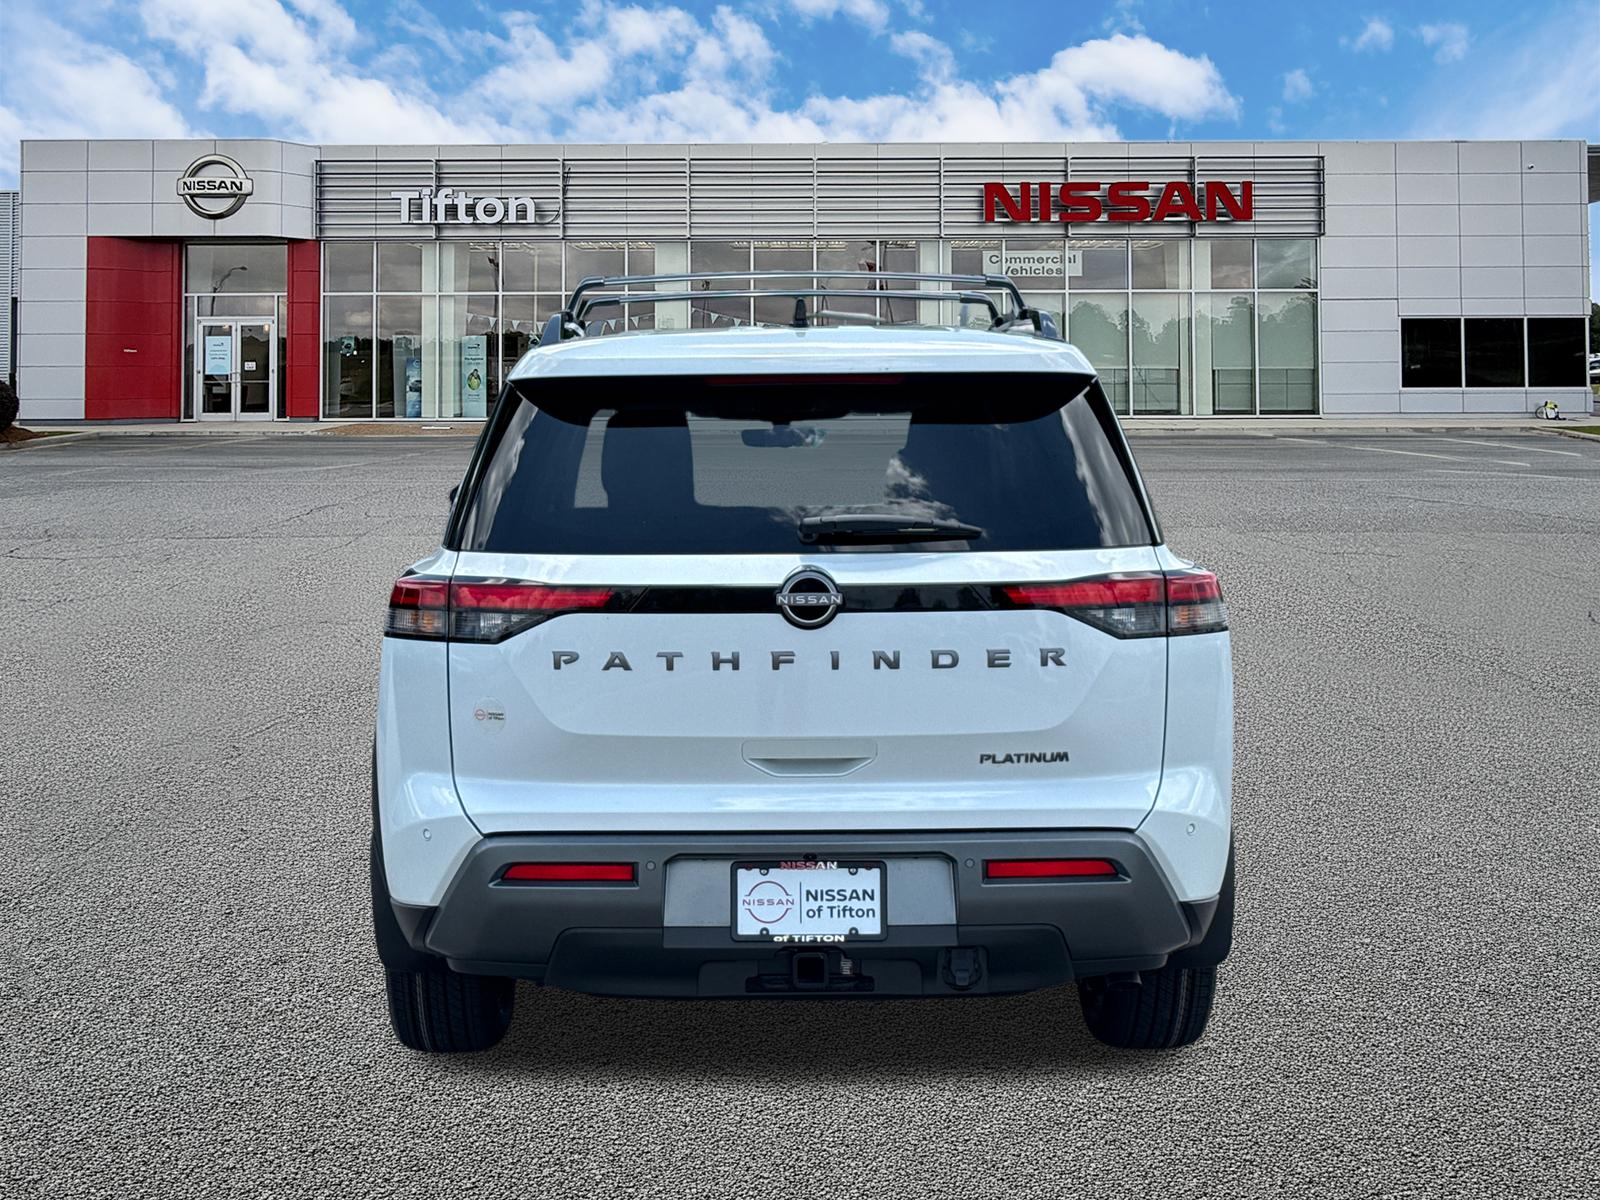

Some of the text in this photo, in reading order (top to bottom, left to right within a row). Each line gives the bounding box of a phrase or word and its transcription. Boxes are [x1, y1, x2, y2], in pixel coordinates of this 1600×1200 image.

[182, 180, 243, 191] NISSAN
[391, 188, 536, 224] Tifton
[983, 181, 1253, 222] NISSAN
[988, 254, 1077, 265] Cmmercil
[778, 595, 841, 604] NISSAN
[552, 647, 1067, 672] PATHFINDER
[979, 751, 1070, 764] PLATINUM
[780, 861, 838, 871] NISSAN
[805, 889, 875, 902] NISSAN
[742, 898, 795, 906] NISSAN
[806, 905, 876, 919] of Tifton
[773, 934, 845, 943] of TIFTON
